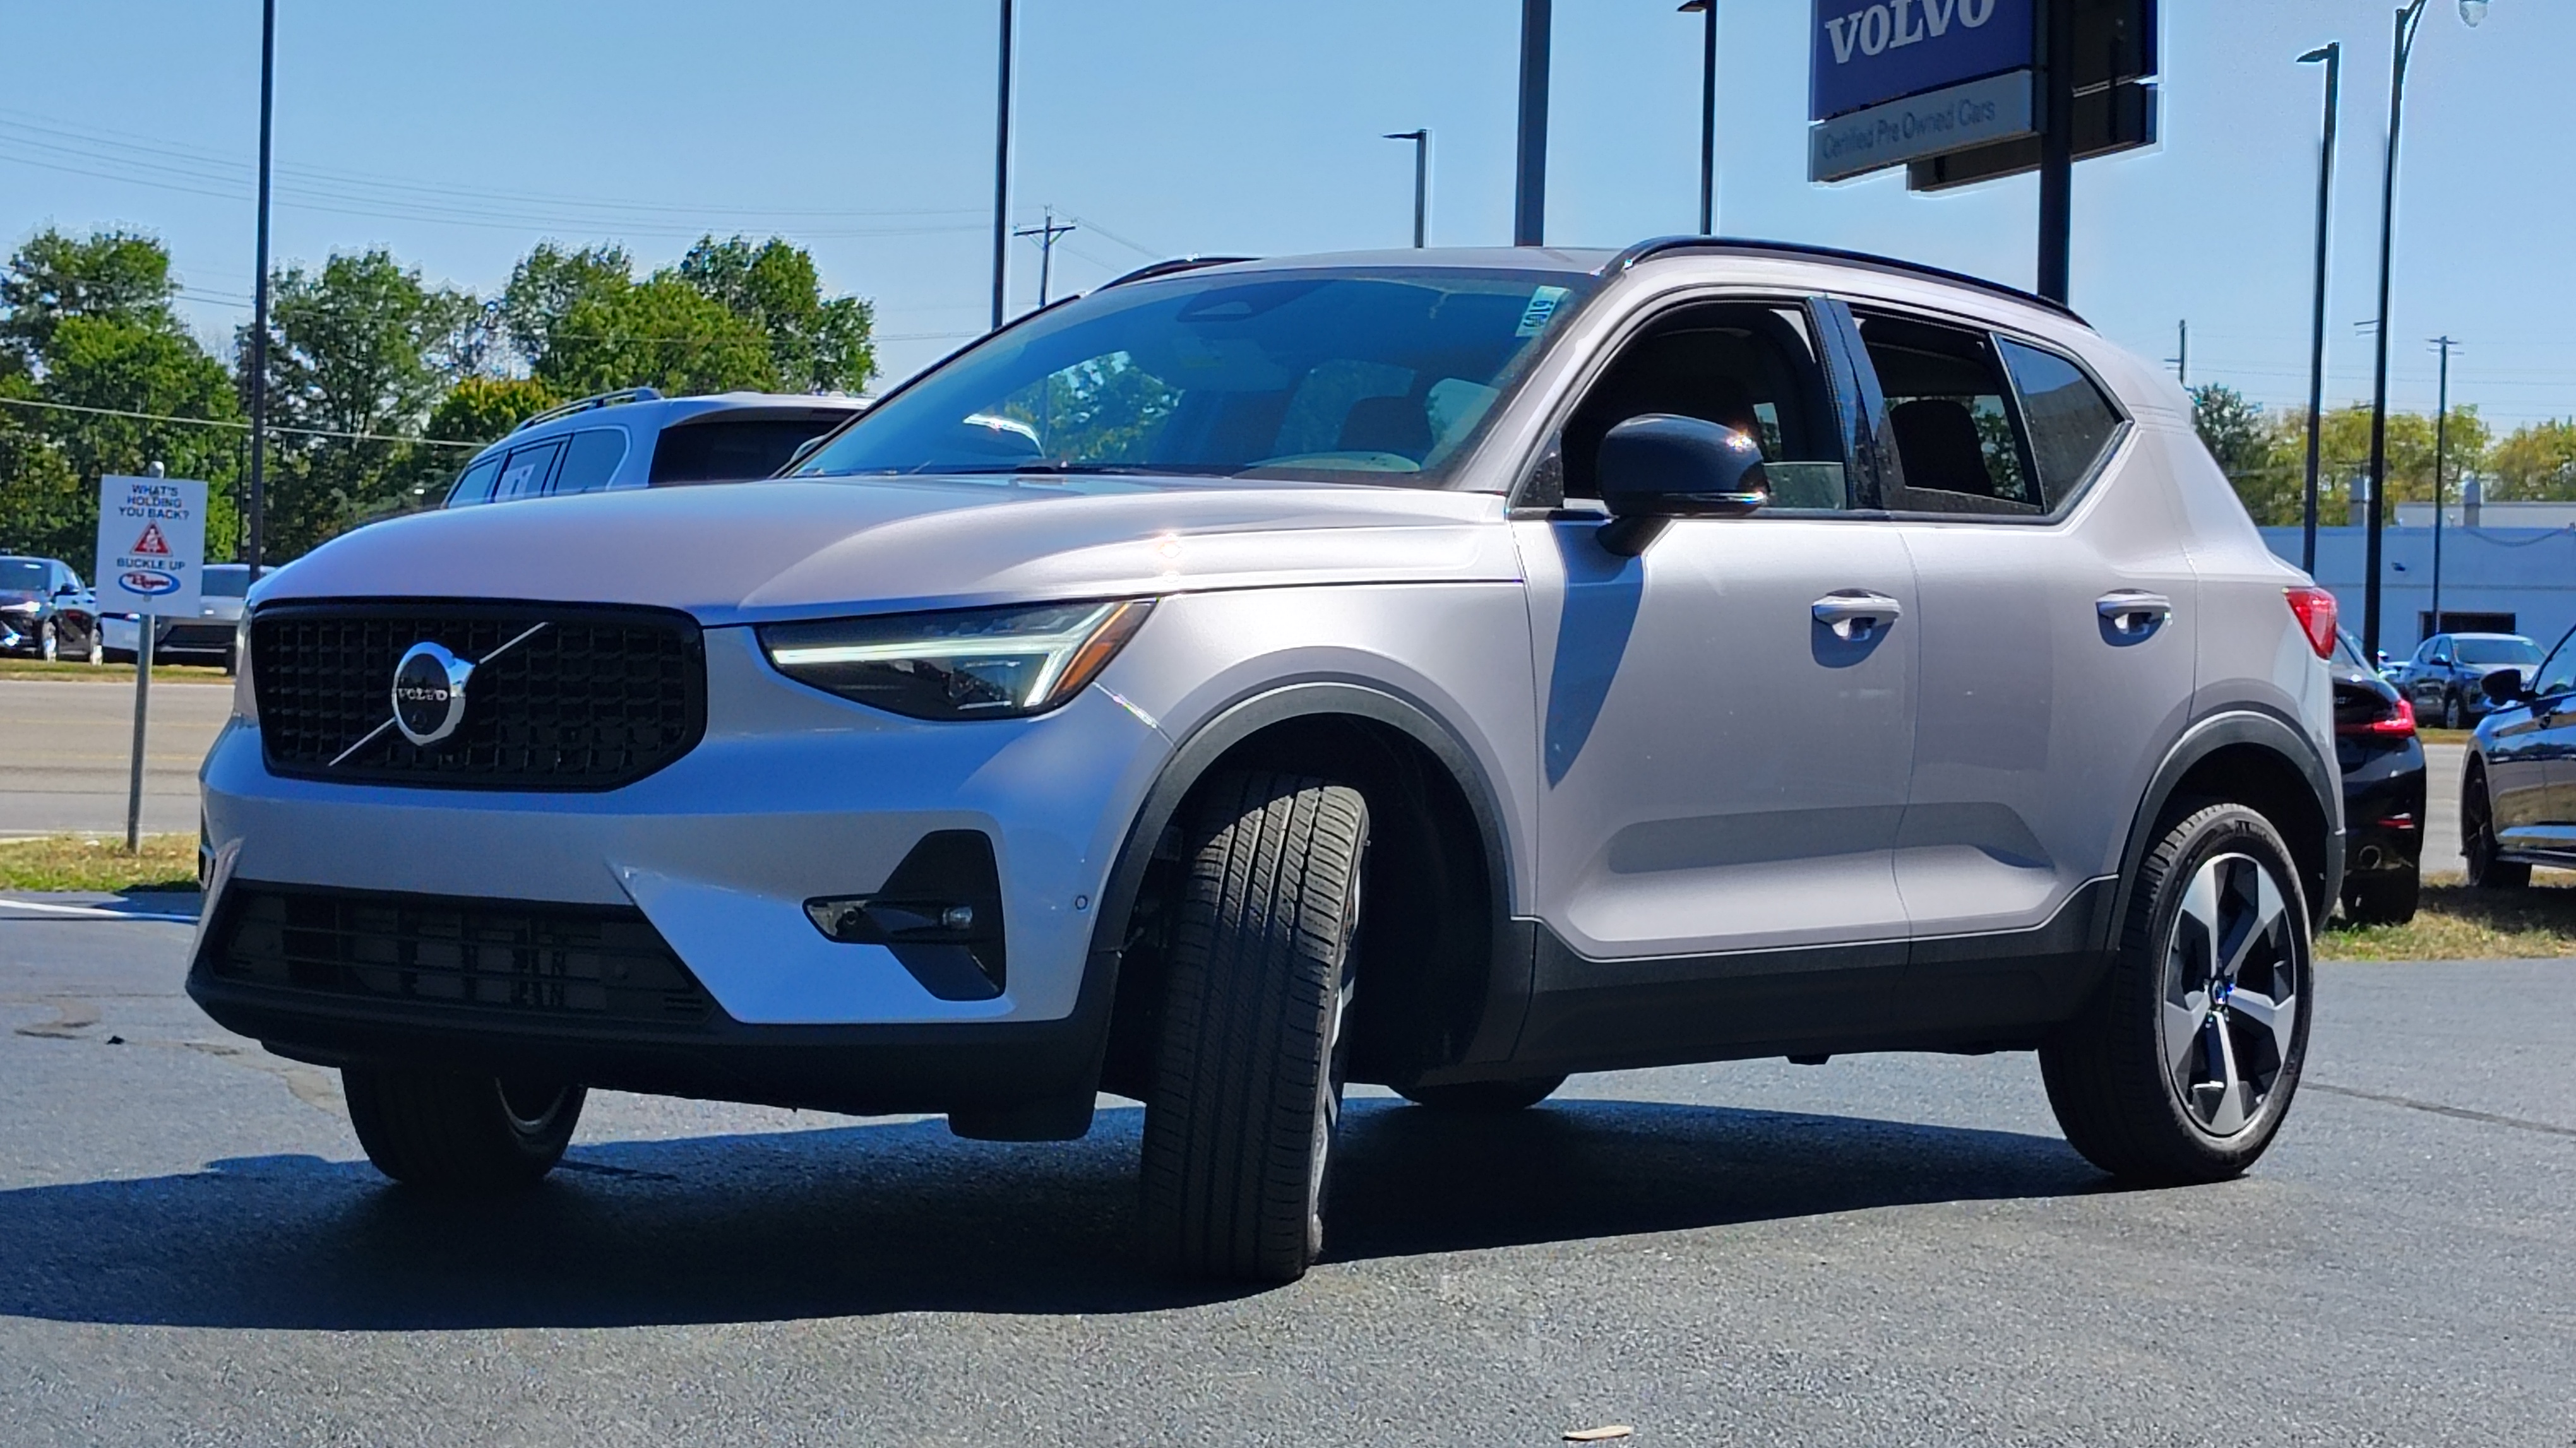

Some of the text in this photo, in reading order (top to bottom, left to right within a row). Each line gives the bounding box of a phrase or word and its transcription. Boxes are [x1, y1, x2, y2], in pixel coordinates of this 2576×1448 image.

[1822, 98, 1996, 160] Certified Pre Owned Cars
[131, 484, 179, 497] WHAT'S
[127, 496, 182, 508] HOLDING
[118, 506, 189, 520] YOU BACK?
[116, 557, 186, 571] BUCKLE UP
